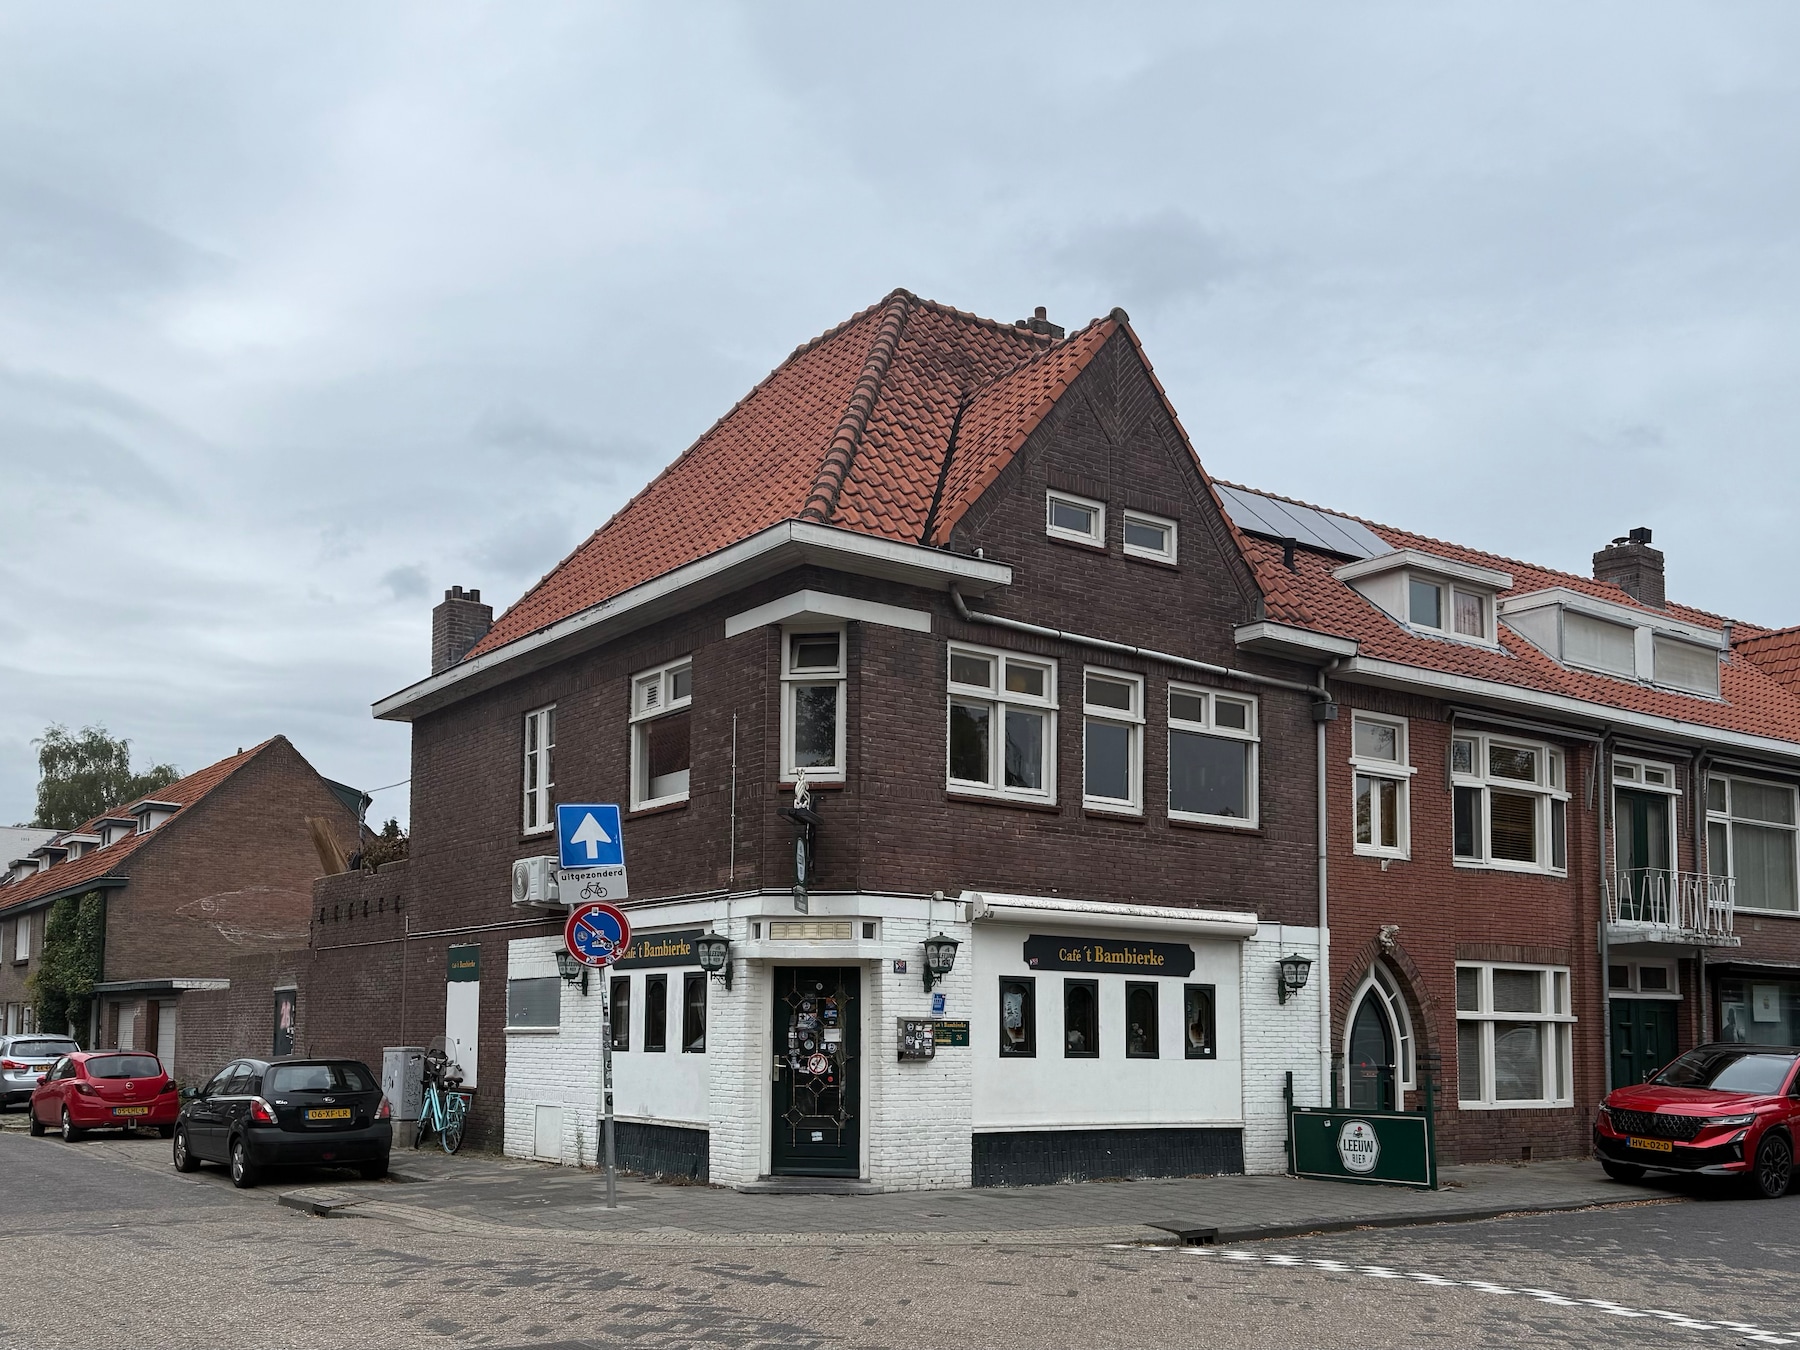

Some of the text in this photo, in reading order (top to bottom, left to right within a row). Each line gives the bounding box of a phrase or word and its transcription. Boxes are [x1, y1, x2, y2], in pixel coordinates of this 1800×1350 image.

[561, 869, 623, 881] uitgezonderd
[643, 938, 691, 958] Bambierke
[1058, 947, 1081, 962] Café
[1094, 945, 1165, 966] Bambierke
[311, 1109, 348, 1119] 06-XF-LR
[1343, 1138, 1374, 1153] LEEUW
[1632, 1138, 1670, 1151] HVL-02-D
[1352, 1153, 1366, 1164] BIER
